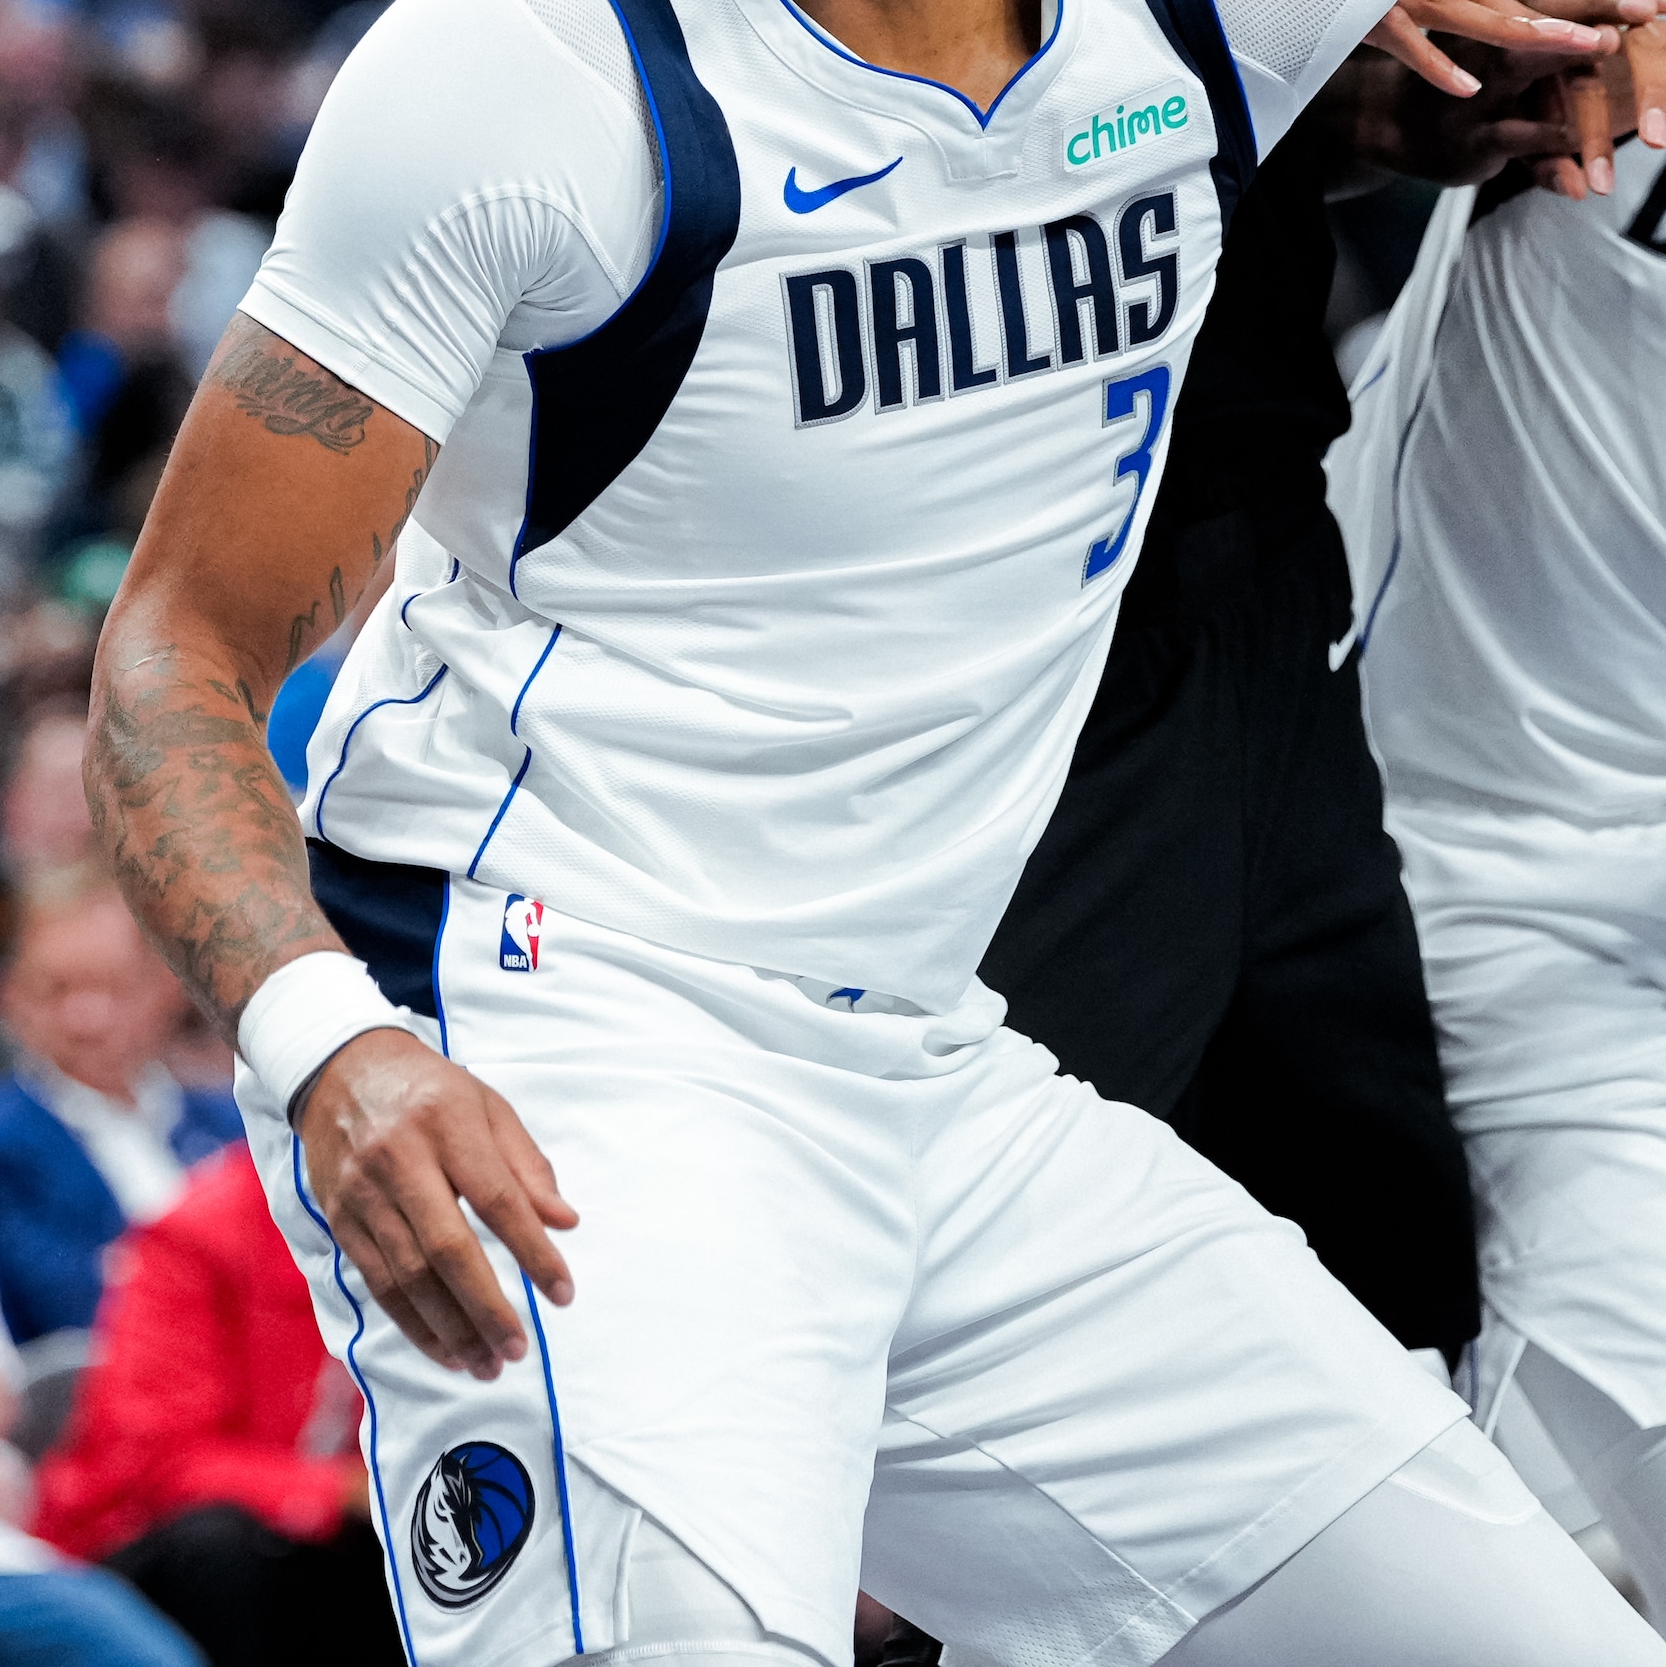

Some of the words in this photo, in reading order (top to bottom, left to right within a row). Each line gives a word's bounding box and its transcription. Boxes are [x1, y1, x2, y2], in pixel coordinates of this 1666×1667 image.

[1066, 95, 1188, 166] chime
[779, 184, 1181, 430] DALLAS
[1080, 360, 1173, 590] 3
[503, 954, 527, 968] NBA
